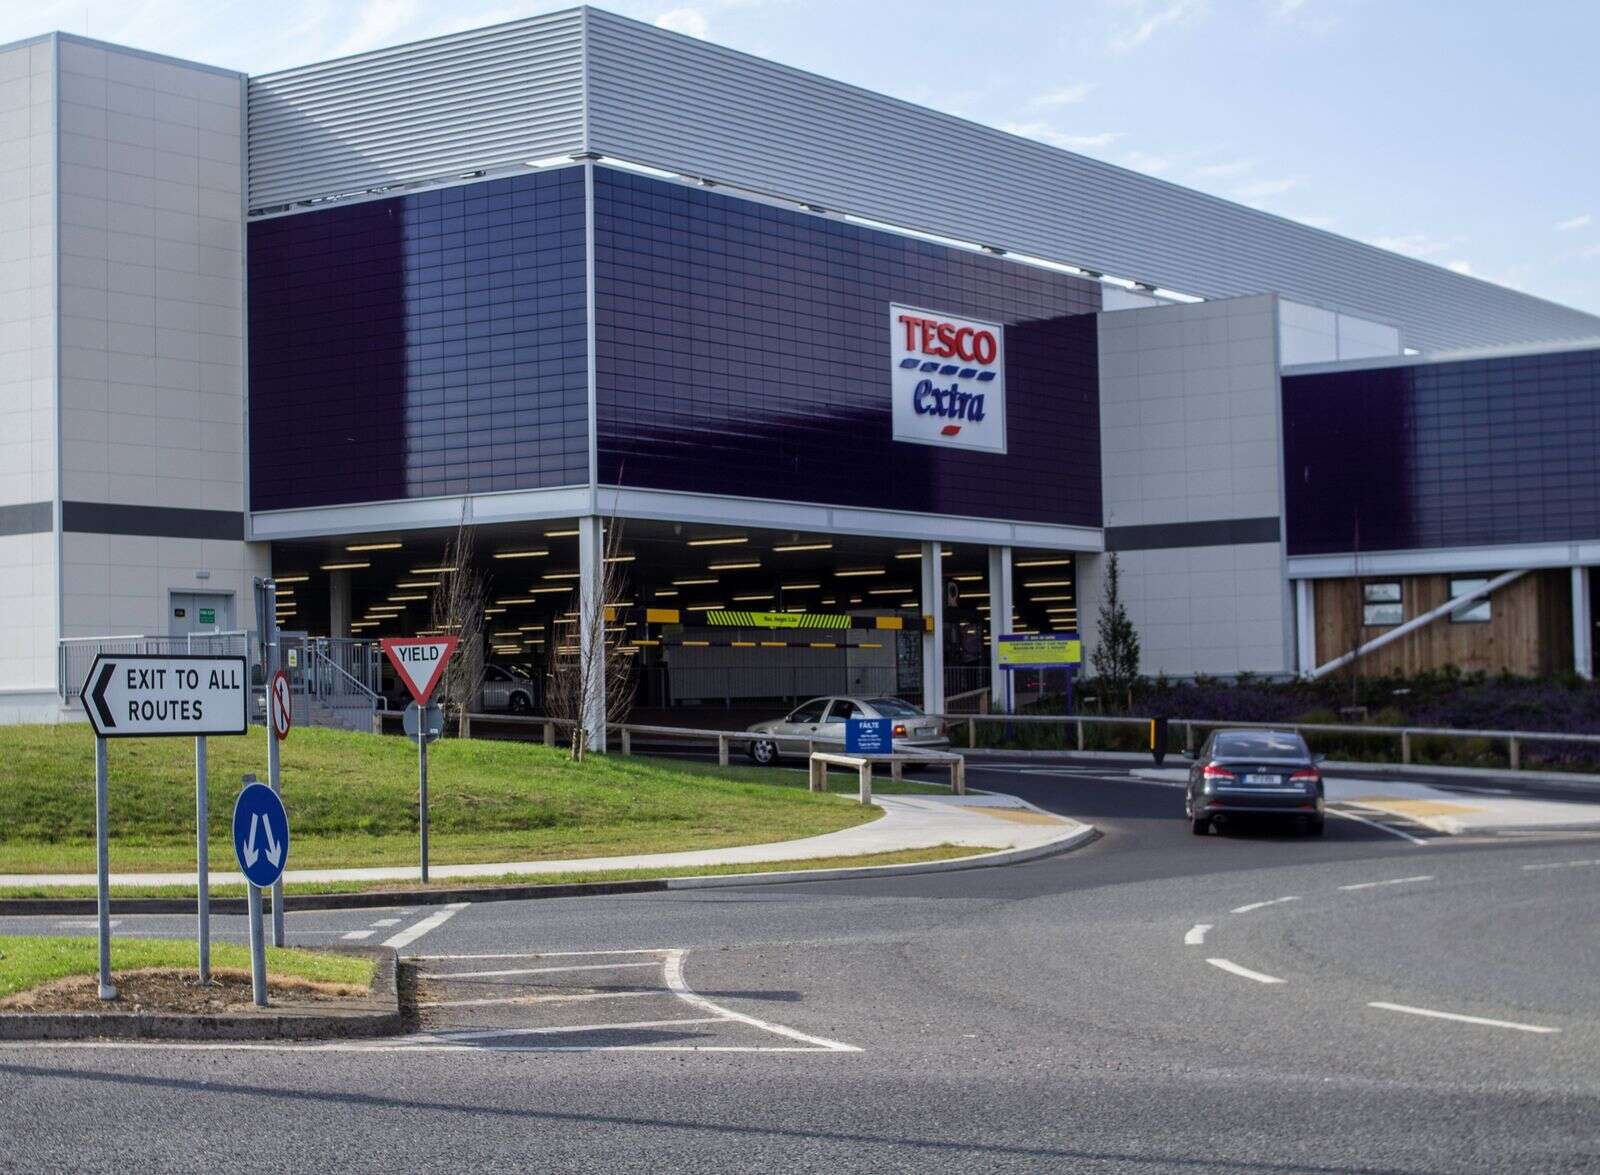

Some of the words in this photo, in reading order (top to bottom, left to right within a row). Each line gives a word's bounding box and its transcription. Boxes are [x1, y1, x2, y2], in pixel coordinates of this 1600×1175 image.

[898, 315, 997, 365] TESCO
[398, 646, 439, 662] YIELD
[127, 669, 167, 690] EXIT
[175, 669, 199, 690] TO
[208, 669, 240, 690] ALL
[128, 700, 203, 721] ROUTES
